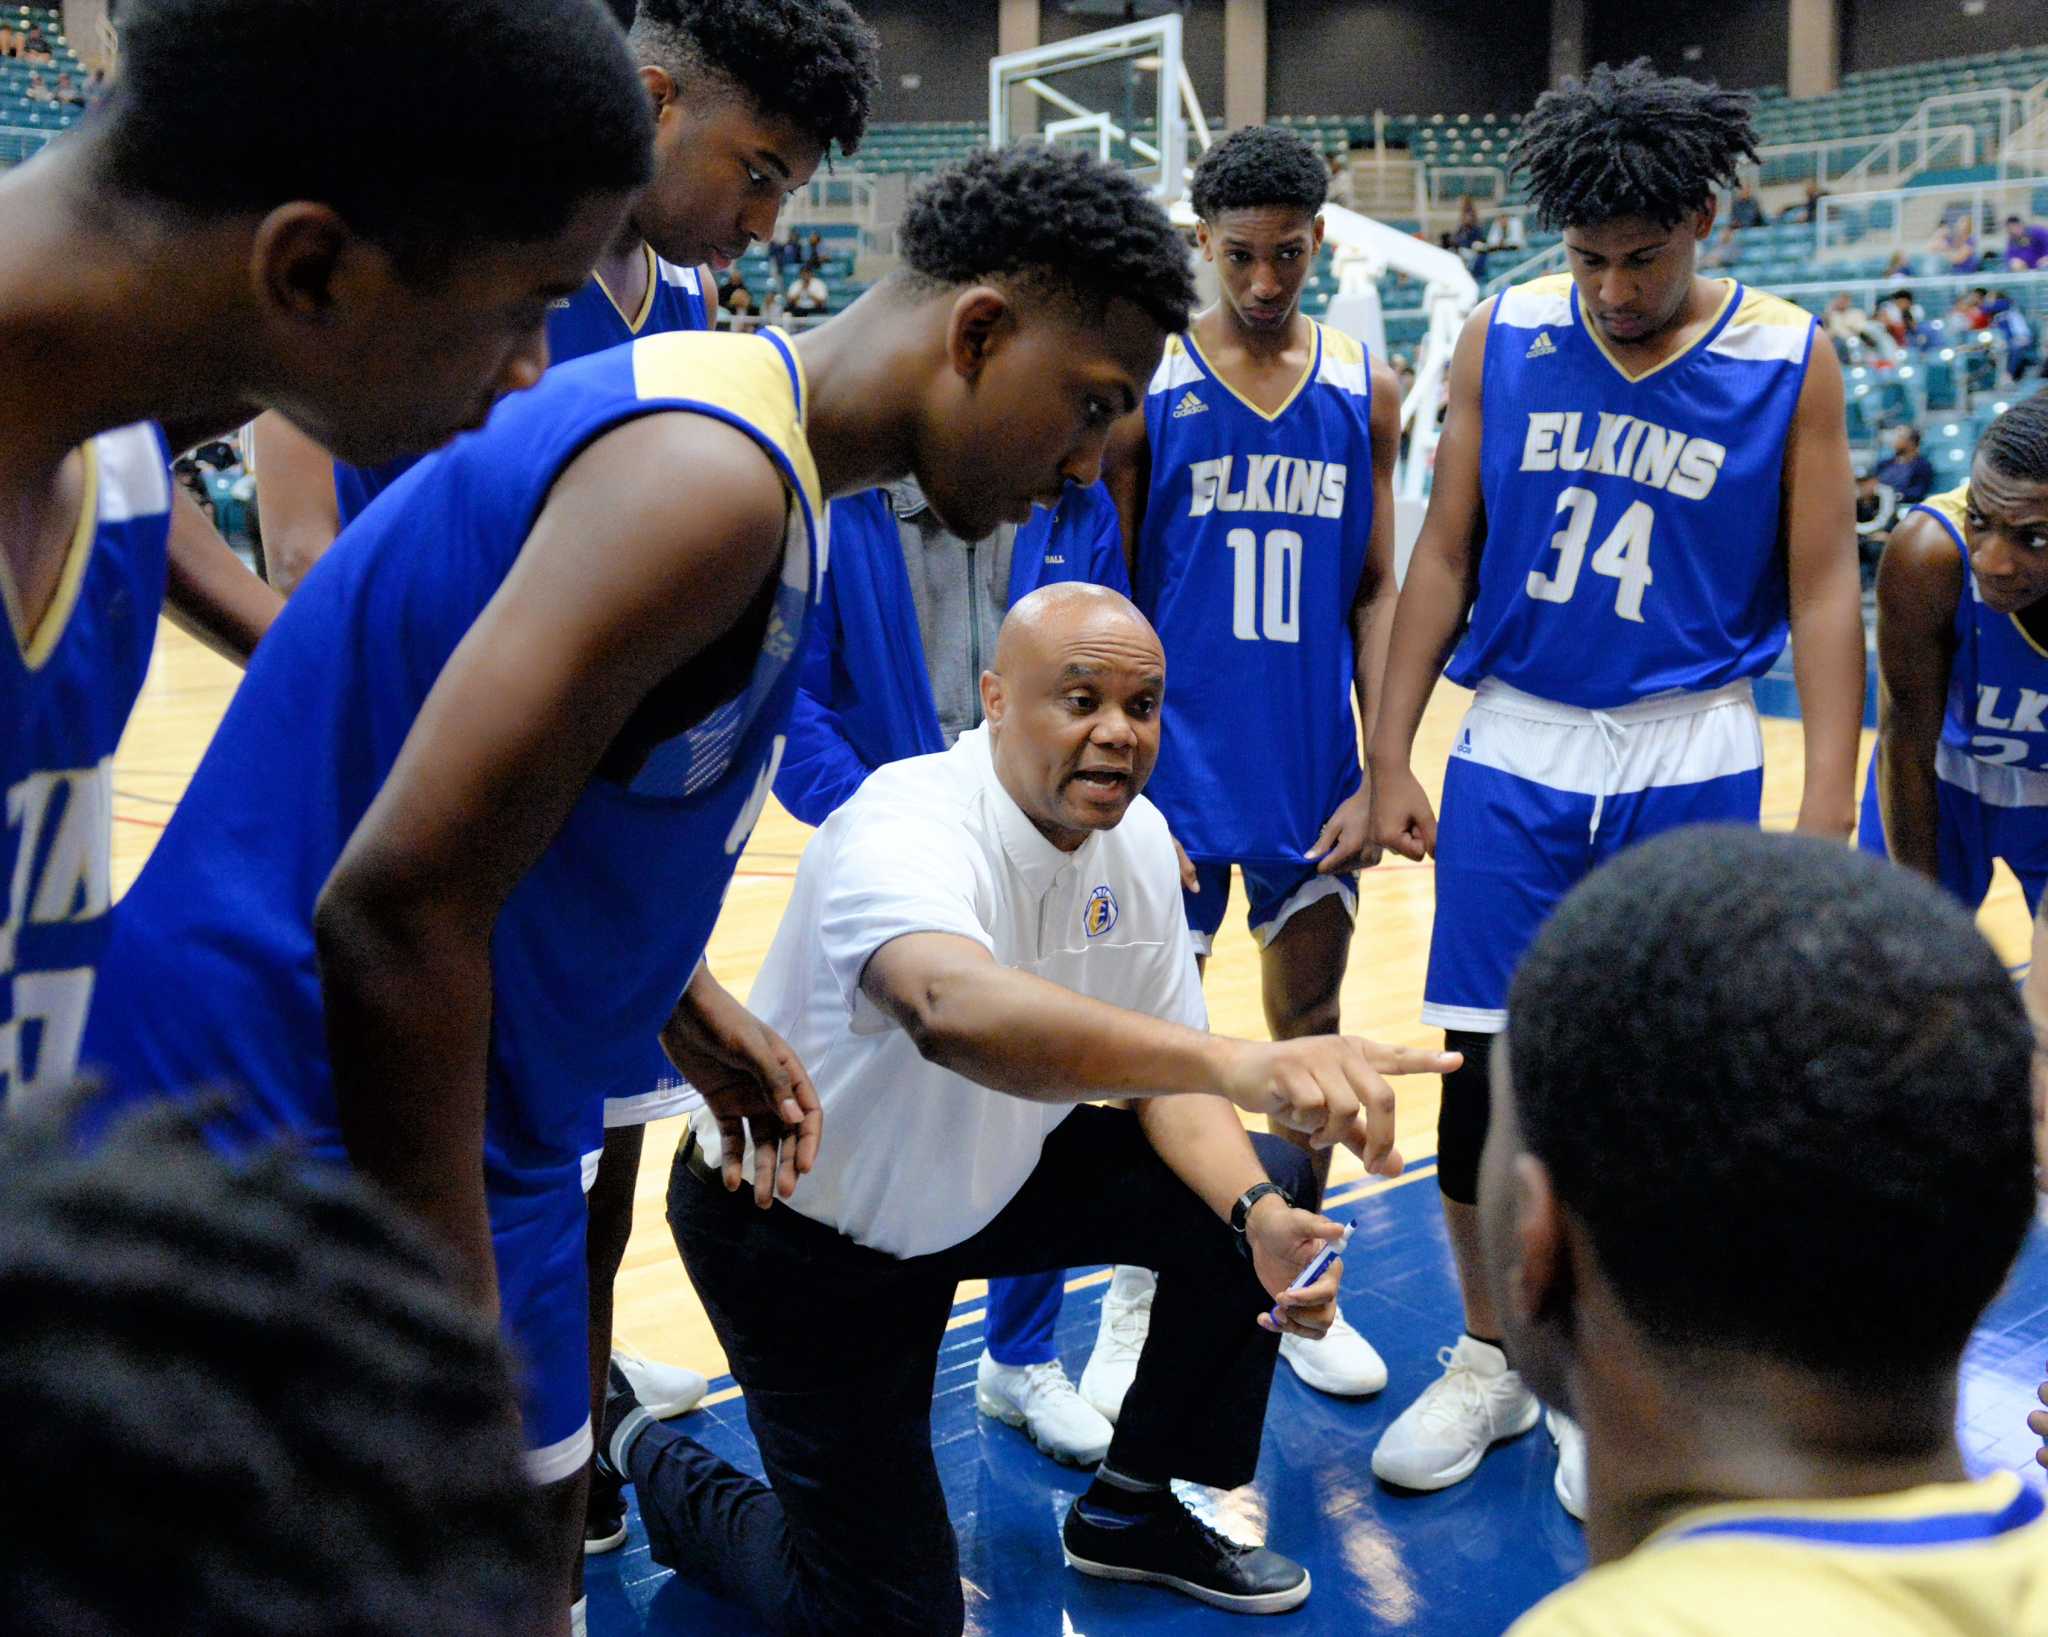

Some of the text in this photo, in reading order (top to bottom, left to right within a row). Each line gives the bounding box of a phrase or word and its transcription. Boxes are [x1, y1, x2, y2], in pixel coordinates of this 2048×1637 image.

[1188, 454, 1347, 519] ELKINS
[1519, 411, 1727, 501] ELKINS
[1226, 527, 1303, 643] 10
[1525, 486, 1655, 624] 34
